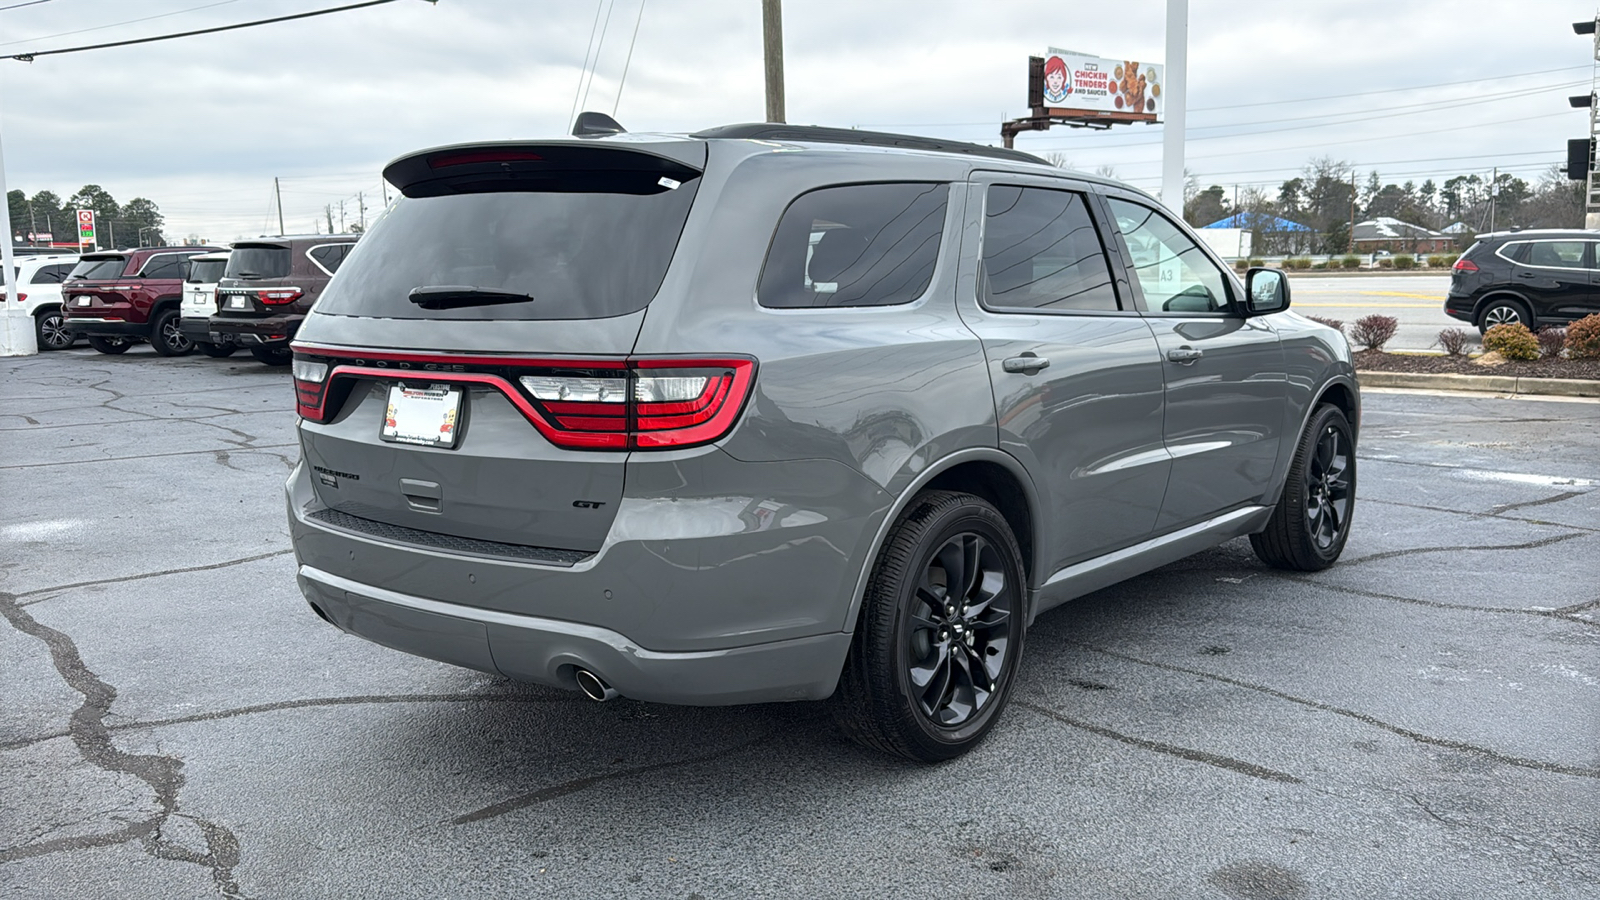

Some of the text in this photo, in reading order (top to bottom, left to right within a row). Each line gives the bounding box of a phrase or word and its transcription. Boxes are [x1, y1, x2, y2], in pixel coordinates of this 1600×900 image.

[1074, 70, 1108, 80] CHICKEN
[1074, 79, 1107, 89] TENDERS
[1160, 269, 1173, 281] A3
[355, 358, 466, 372] DODGE
[572, 500, 606, 509] GT
